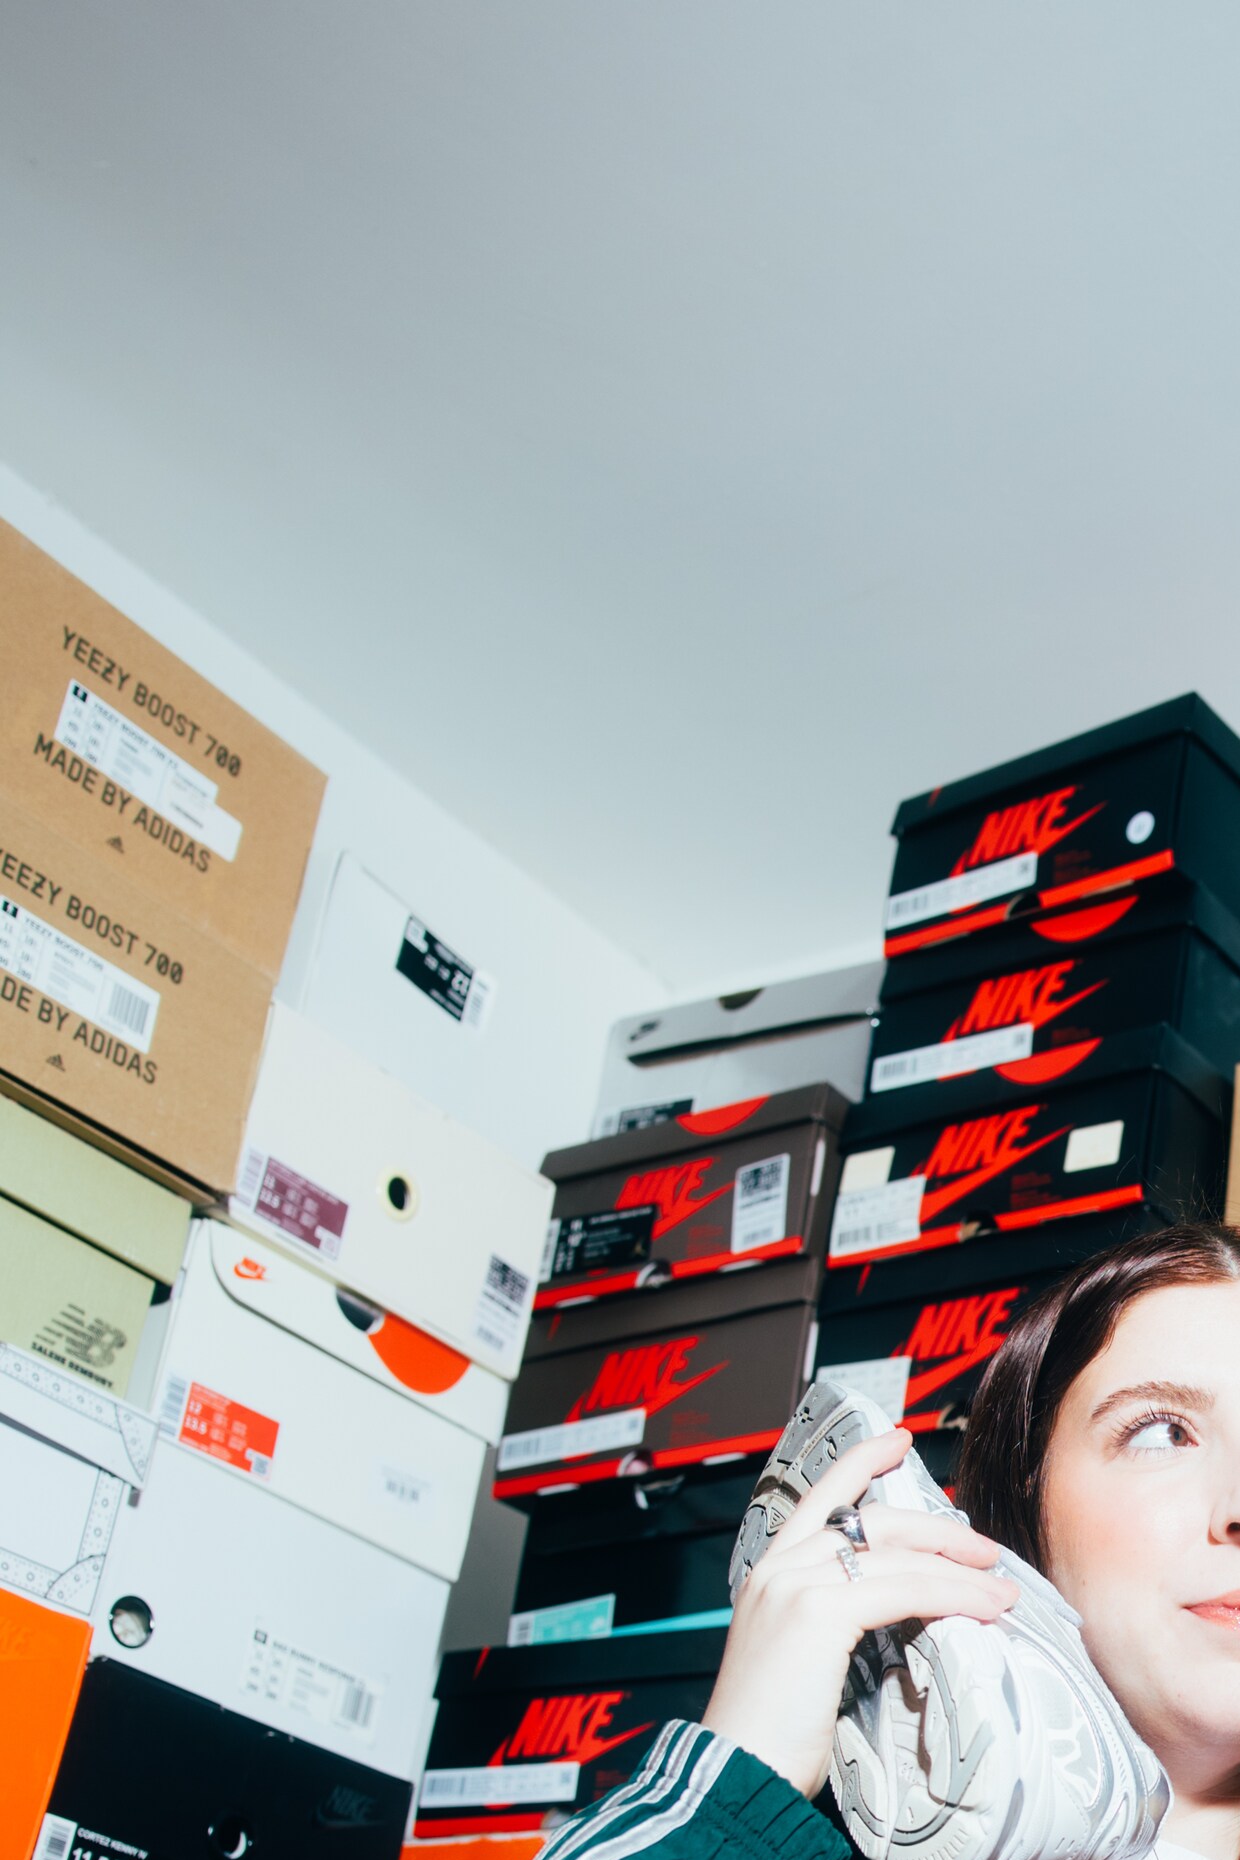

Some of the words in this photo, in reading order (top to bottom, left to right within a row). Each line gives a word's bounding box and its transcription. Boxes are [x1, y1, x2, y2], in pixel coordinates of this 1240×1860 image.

[61, 625, 132, 693] YEEZY
[133, 682, 202, 746] BOOST
[204, 733, 242, 778] 700
[34, 733, 99, 794] MADE
[100, 780, 132, 816] BY
[132, 805, 212, 873] ADIDAS
[968, 786, 1076, 868] NIKE
[0, 848, 62, 905] EEZY
[65, 896, 139, 956] BOOST
[144, 942, 185, 986] 700
[0, 975, 33, 1013] DE
[37, 998, 70, 1032] BY
[73, 1021, 158, 1085] ADIDAS
[962, 960, 1076, 1036] NIKE
[925, 1105, 1039, 1179] NIKE
[615, 1156, 713, 1215] NIKE
[907, 1287, 1020, 1360] NIKE
[587, 1337, 700, 1411] NIKE
[507, 1691, 623, 1759] NIKE
[77, 1827, 112, 1848] CORTEZ
[110, 1839, 139, 1857] KENNY
